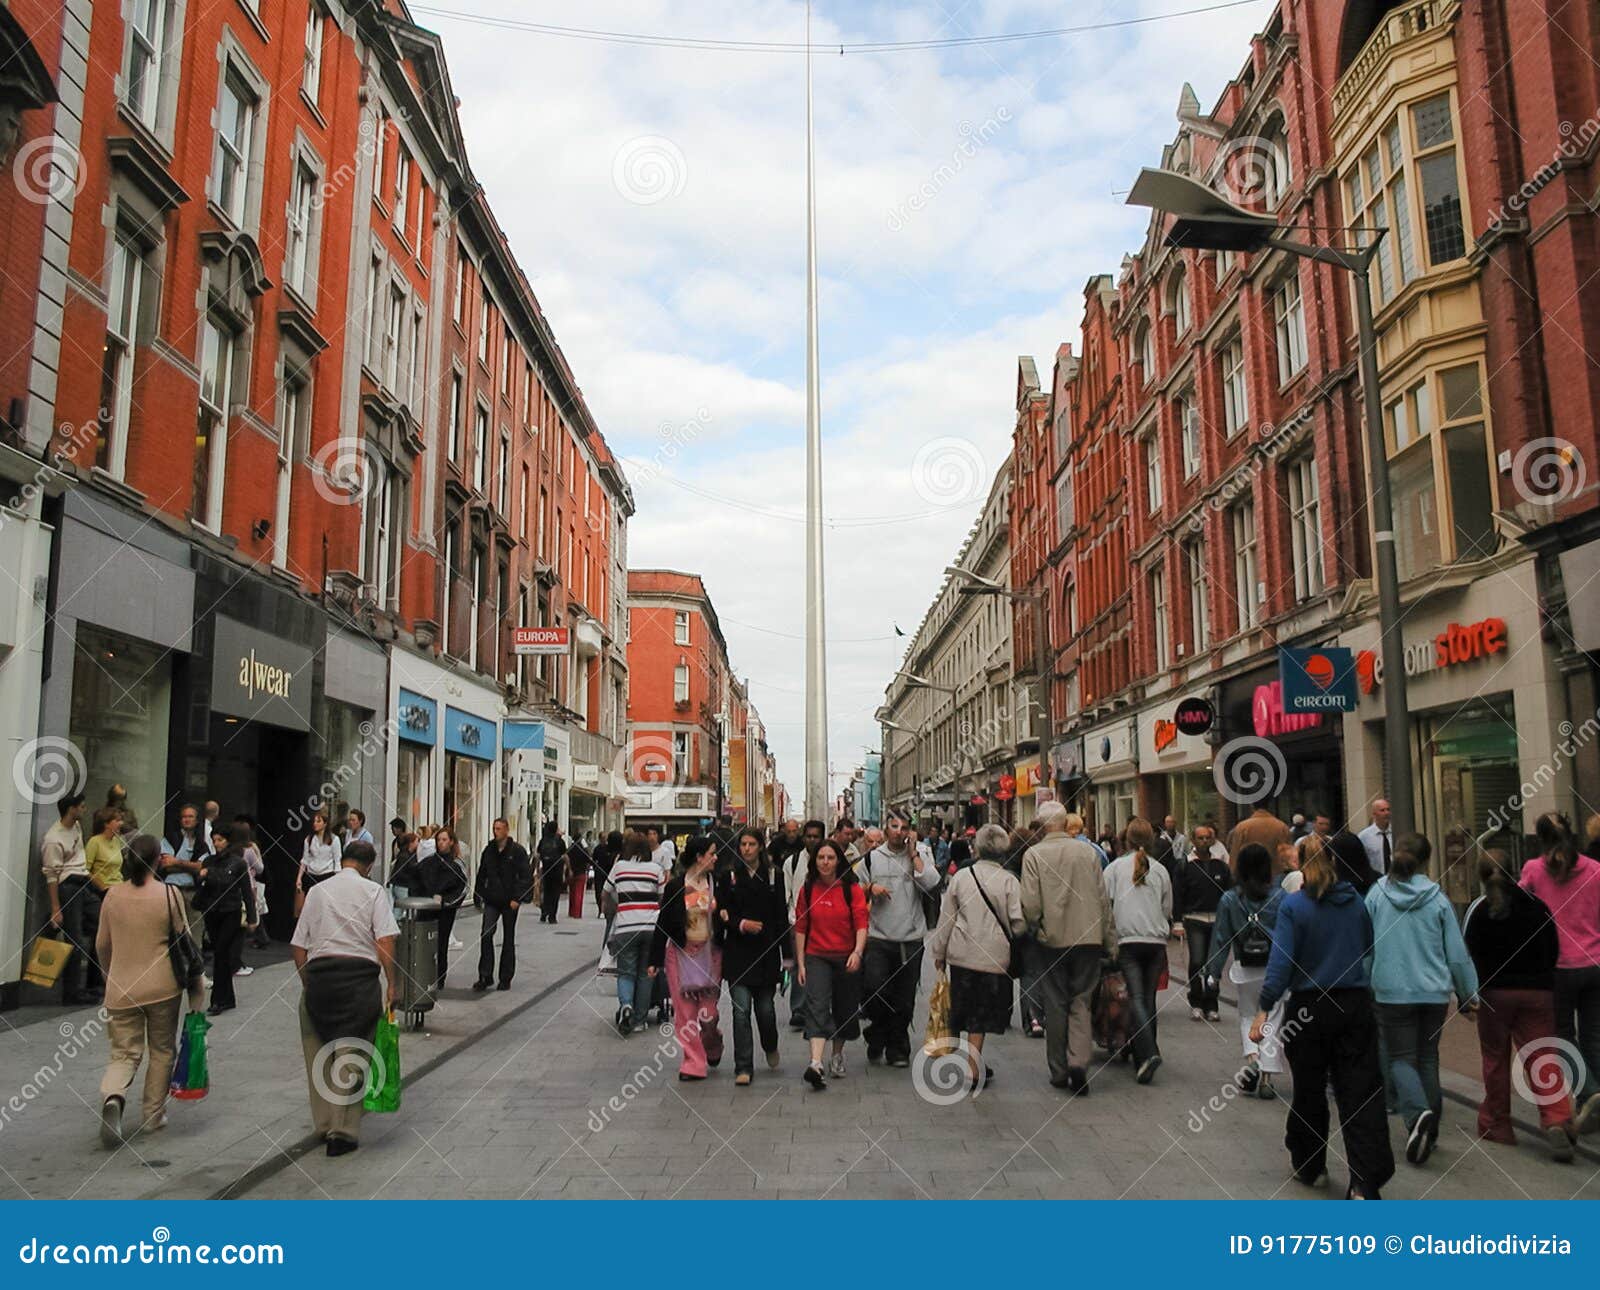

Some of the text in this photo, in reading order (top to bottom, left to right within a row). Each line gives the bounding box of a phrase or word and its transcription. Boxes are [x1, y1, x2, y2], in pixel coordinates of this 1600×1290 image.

[517, 631, 559, 643] EUROPA
[1374, 617, 1506, 685] eom store
[1178, 711, 1210, 723] HMV
